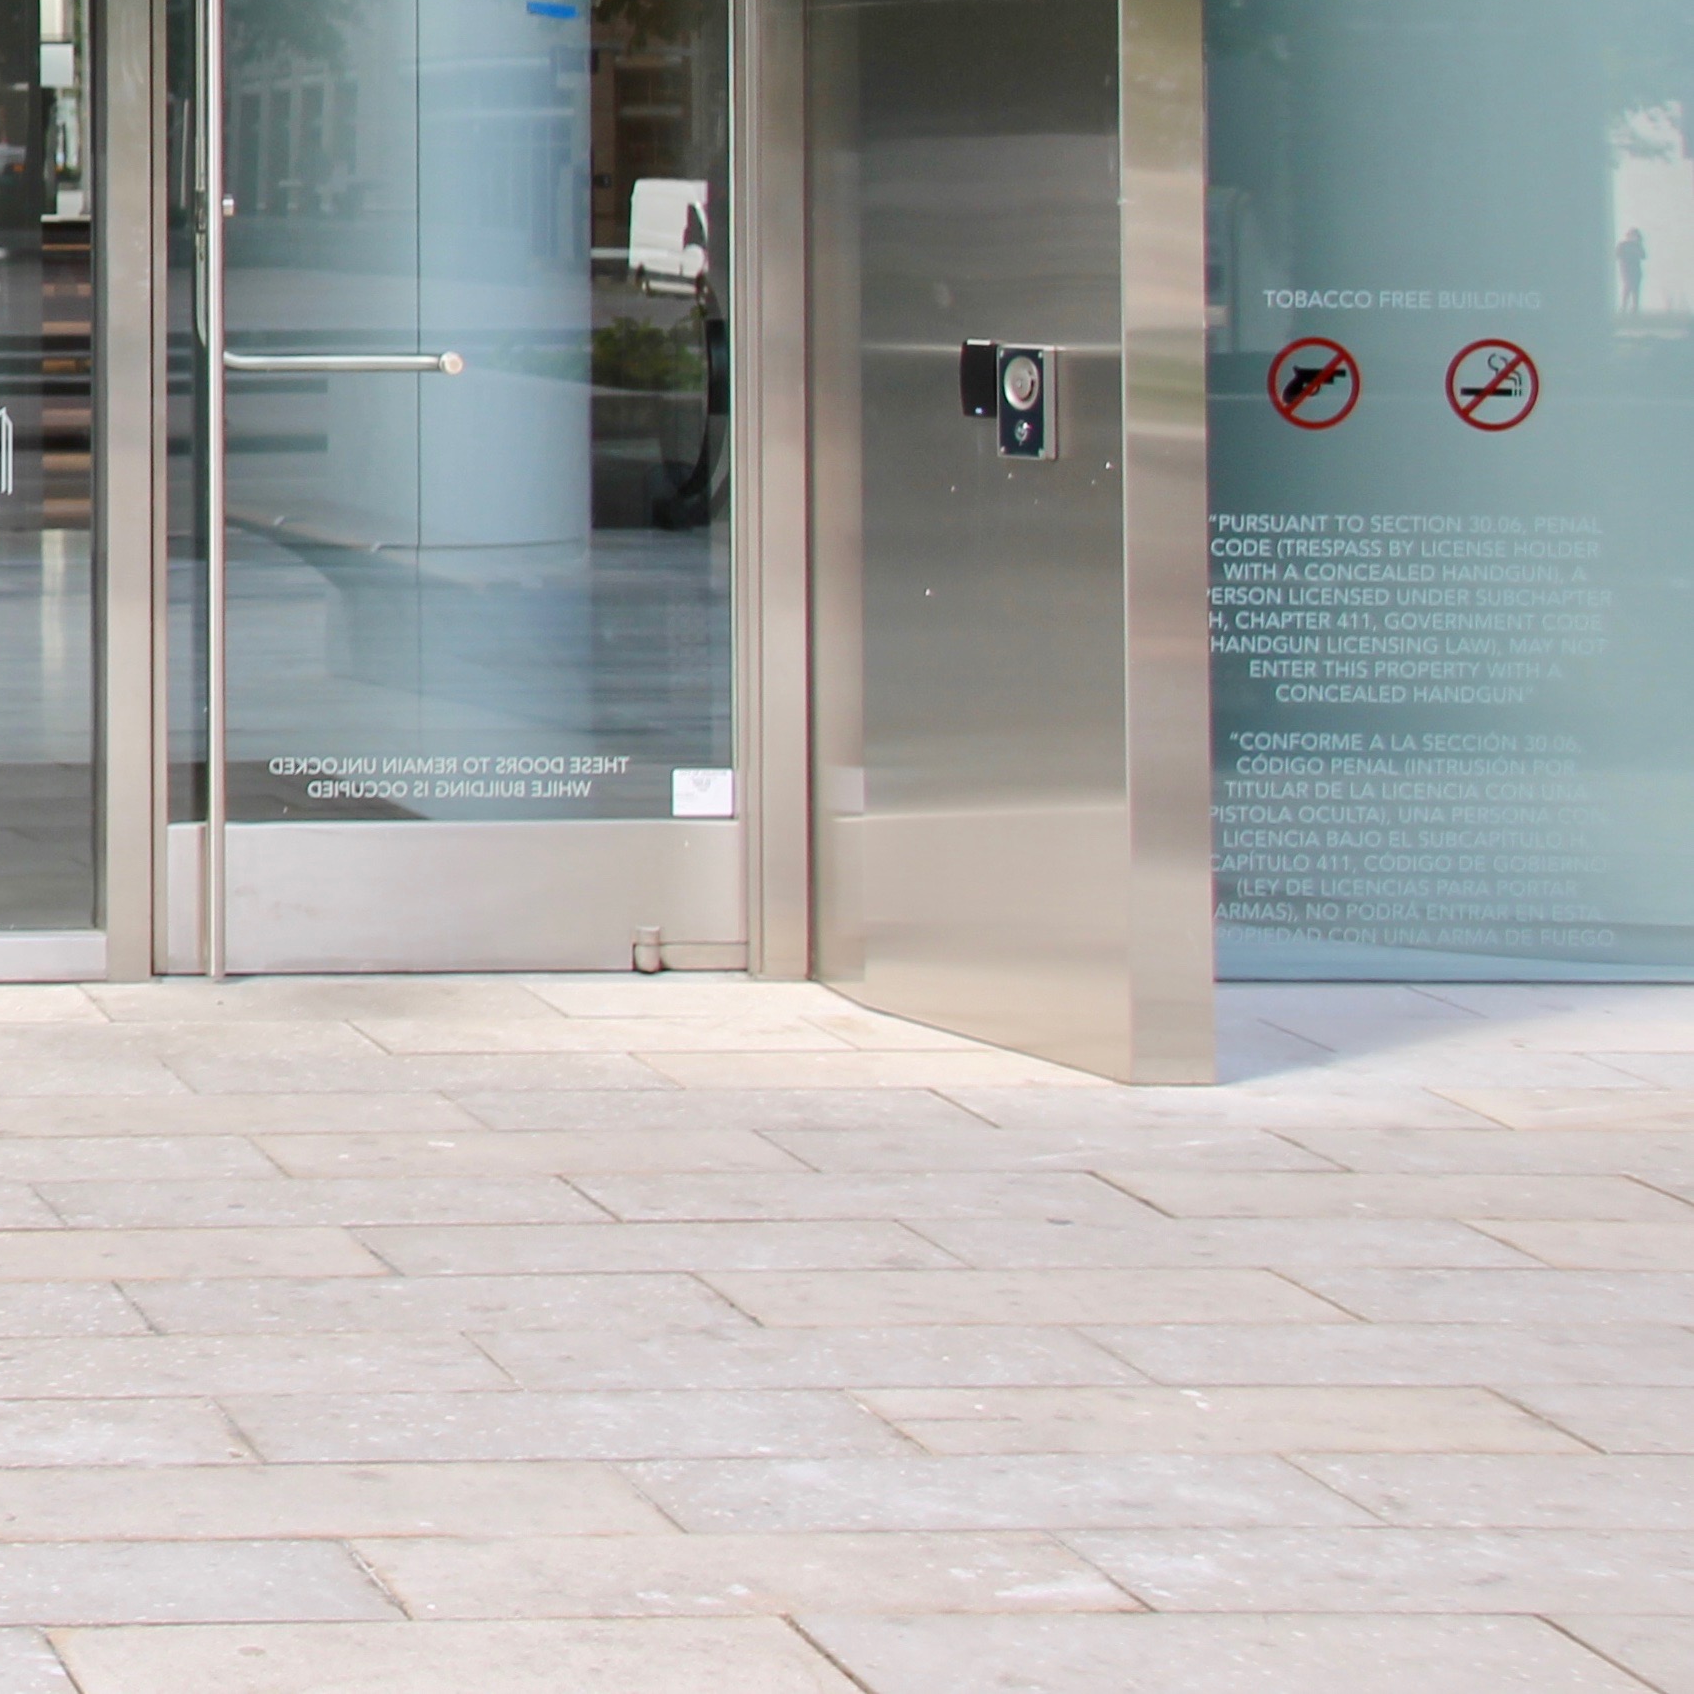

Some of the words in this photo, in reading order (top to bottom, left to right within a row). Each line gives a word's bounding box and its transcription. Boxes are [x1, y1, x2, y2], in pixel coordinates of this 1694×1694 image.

[1264, 289, 1373, 309] TOBACCO
[1380, 289, 1431, 309] FREE
[1438, 289, 1540, 309] BUILDING
[1335, 515, 1363, 533] TO
[1370, 515, 1461, 533] SECTION
[1534, 516, 1602, 535] PENAL
[1211, 539, 1272, 558] CODE
[1276, 539, 1382, 560] (TRESPASS
[1389, 539, 1414, 558] BY
[1421, 539, 1507, 558] LICENSE
[1513, 541, 1600, 559] HOLDER
[1224, 563, 1276, 581] WITH
[1283, 563, 1299, 581] A
[1304, 563, 1435, 581] CONCEALED
[1571, 566, 1587, 583] A
[1206, 587, 1282, 606] ERSON
[1288, 587, 1389, 606] LICENSED
[1397, 587, 1469, 606] UNDER
[1235, 611, 1331, 630] CHAPTER
[1336, 611, 1377, 633] 411,
[1384, 611, 1534, 630] GOVERNMENT
[1326, 636, 1439, 654] LICENSING
[1509, 638, 1552, 655] MAY
[1561, 638, 1608, 656] NOT
[1249, 660, 1316, 679] ENTER
[1323, 660, 1368, 679] THIS
[1374, 660, 1480, 679] PROPERTY
[1486, 660, 1540, 679] WITH
[1547, 660, 1562, 679] A
[1275, 684, 1406, 703] CONCEALED
[1369, 732, 1384, 751] A
[1390, 732, 1416, 751] LA
[1422, 731, 1517, 752] SECCIÓN
[1236, 754, 1323, 776] CÓDIGO
[1330, 759, 1398, 776] PENAL
[1532, 759, 1576, 776] POR
[1225, 782, 1308, 800] TITULAR
[1315, 782, 1342, 800] DE
[1349, 782, 1375, 800] LA
[1382, 782, 1480, 800] LICENCIA
[1485, 782, 1534, 800] CON
[1223, 831, 1320, 849] LICENCIA
[1326, 831, 1381, 849] BAJO
[1389, 831, 1413, 849] EL
